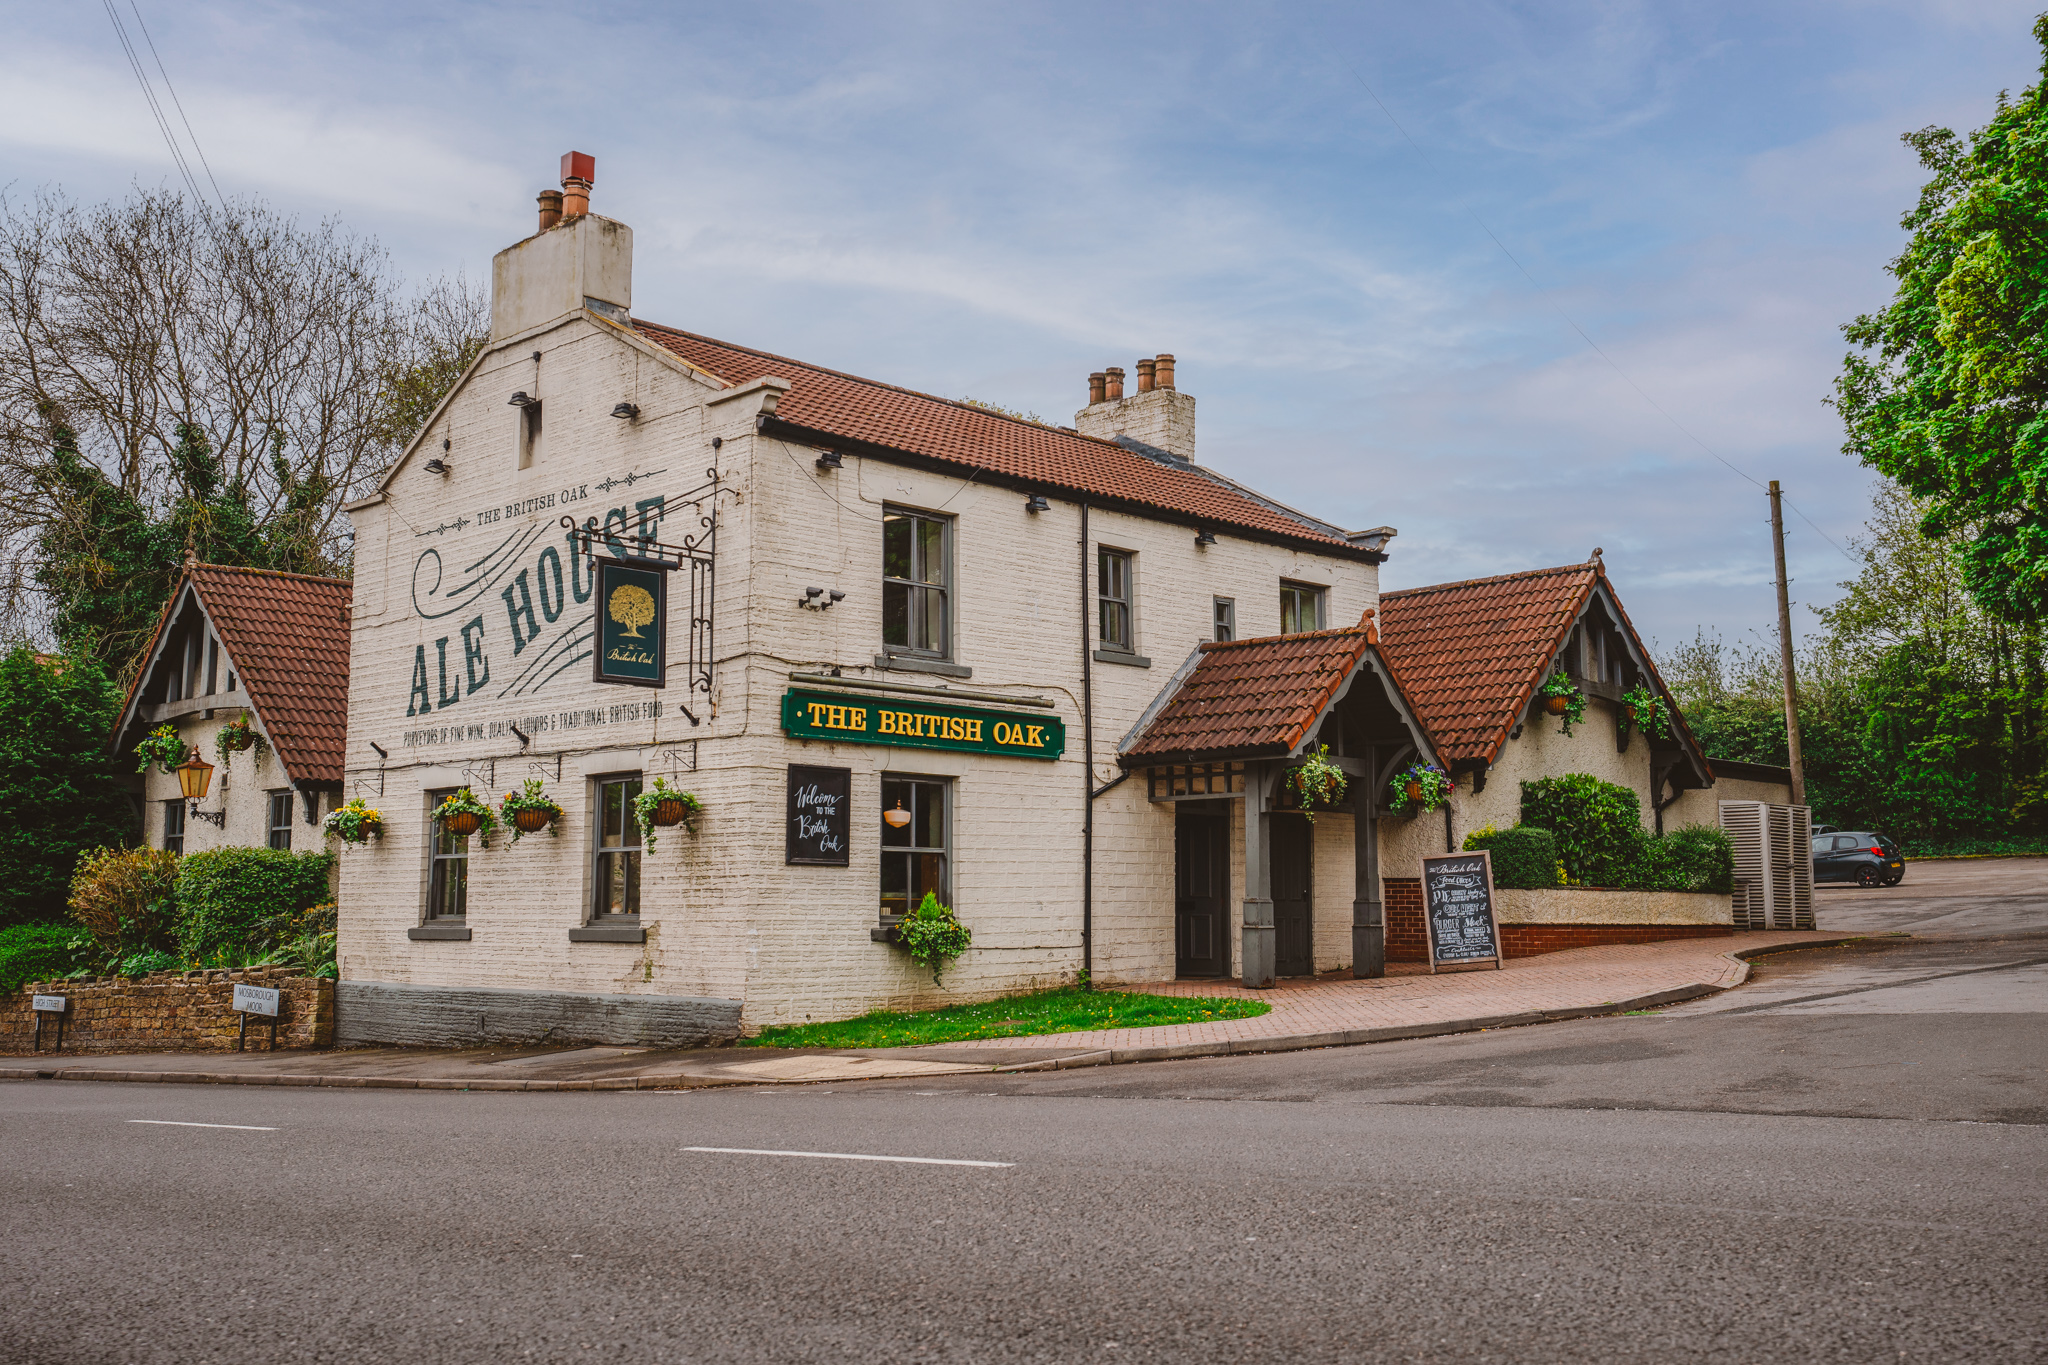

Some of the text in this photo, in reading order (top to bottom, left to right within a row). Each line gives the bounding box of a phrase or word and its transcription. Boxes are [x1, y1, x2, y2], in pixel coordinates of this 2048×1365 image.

[476, 484, 588, 526] THE BRITISH OAK
[406, 495, 665, 717] ALE HOUSE
[606, 648, 655, 665] British Oak
[403, 728, 438, 747] PURVEYORS
[440, 727, 449, 743] OF
[450, 725, 465, 743] FINE
[519, 715, 549, 735] LIQUORS
[559, 707, 606, 729] TRADITIONAL
[609, 703, 640, 723] BRITISH
[642, 701, 663, 719] FOOD
[807, 702, 1045, 748] THE BRITISH OAK
[794, 783, 844, 808] Welcome
[816, 806, 836, 816] TO THE
[793, 814, 830, 839] British
[820, 834, 844, 852] Oak
[238, 987, 274, 1001] MOSBOROUGH
[246, 1001, 263, 1012] MOOR
